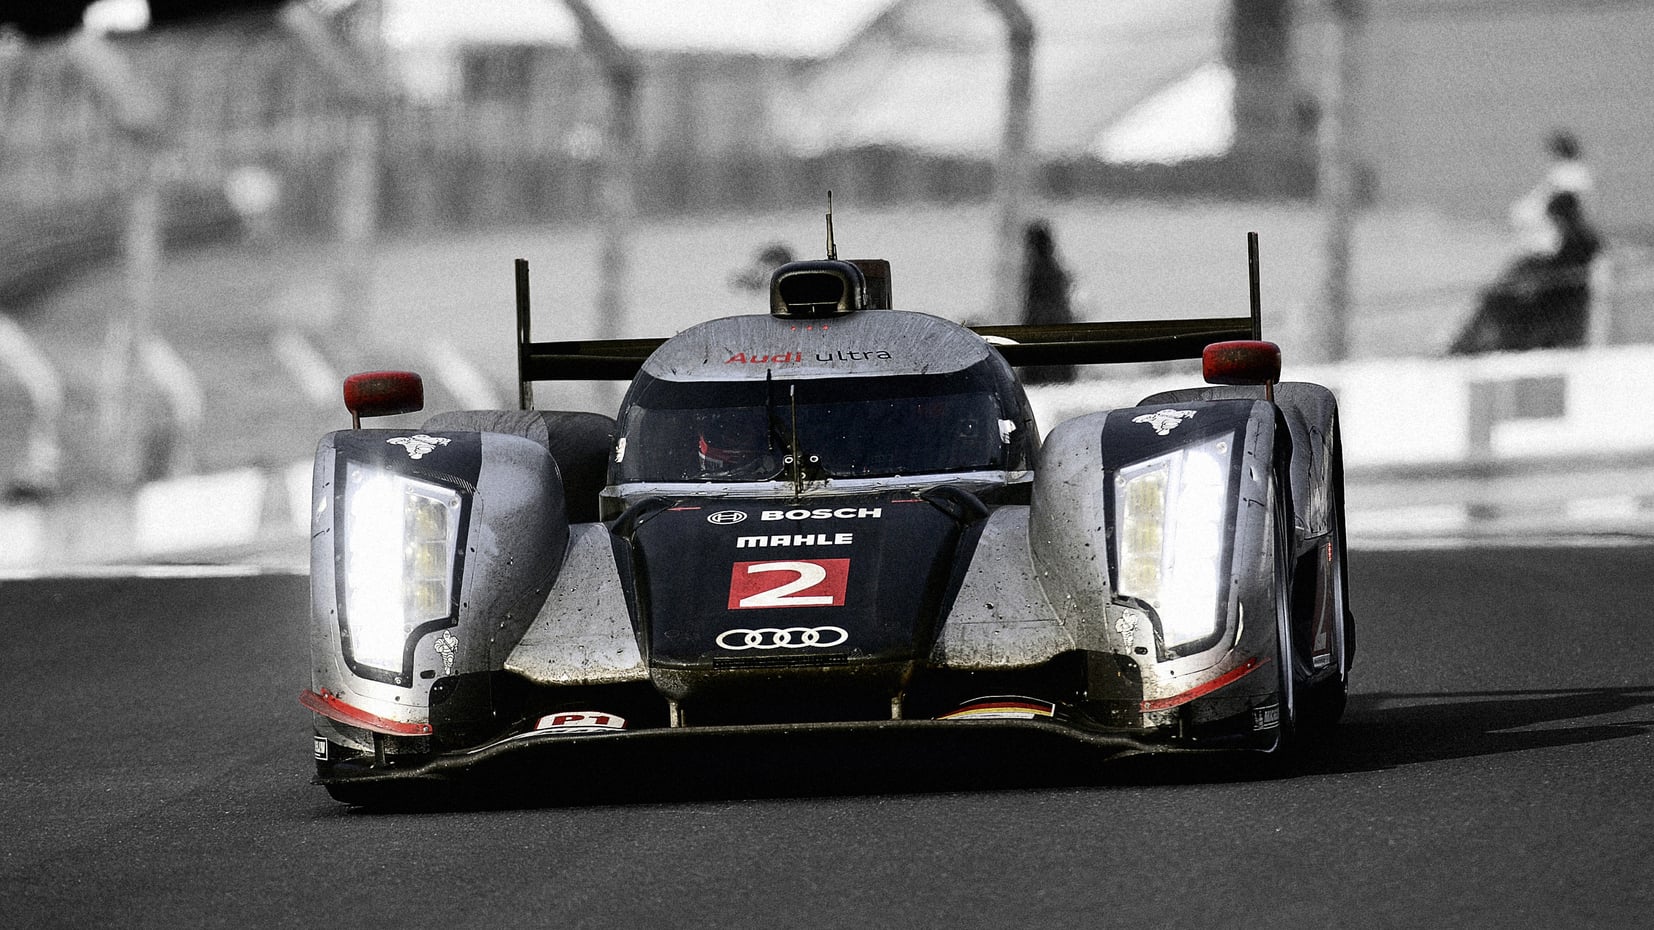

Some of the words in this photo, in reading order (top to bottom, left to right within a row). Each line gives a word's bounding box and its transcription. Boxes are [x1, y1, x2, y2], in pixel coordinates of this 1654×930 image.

[725, 351, 802, 364] Audi
[815, 350, 892, 362] ultra
[760, 507, 882, 521] BOSCH
[736, 533, 853, 548] MAHLE
[739, 561, 834, 608] 2
[552, 714, 610, 726] P1
